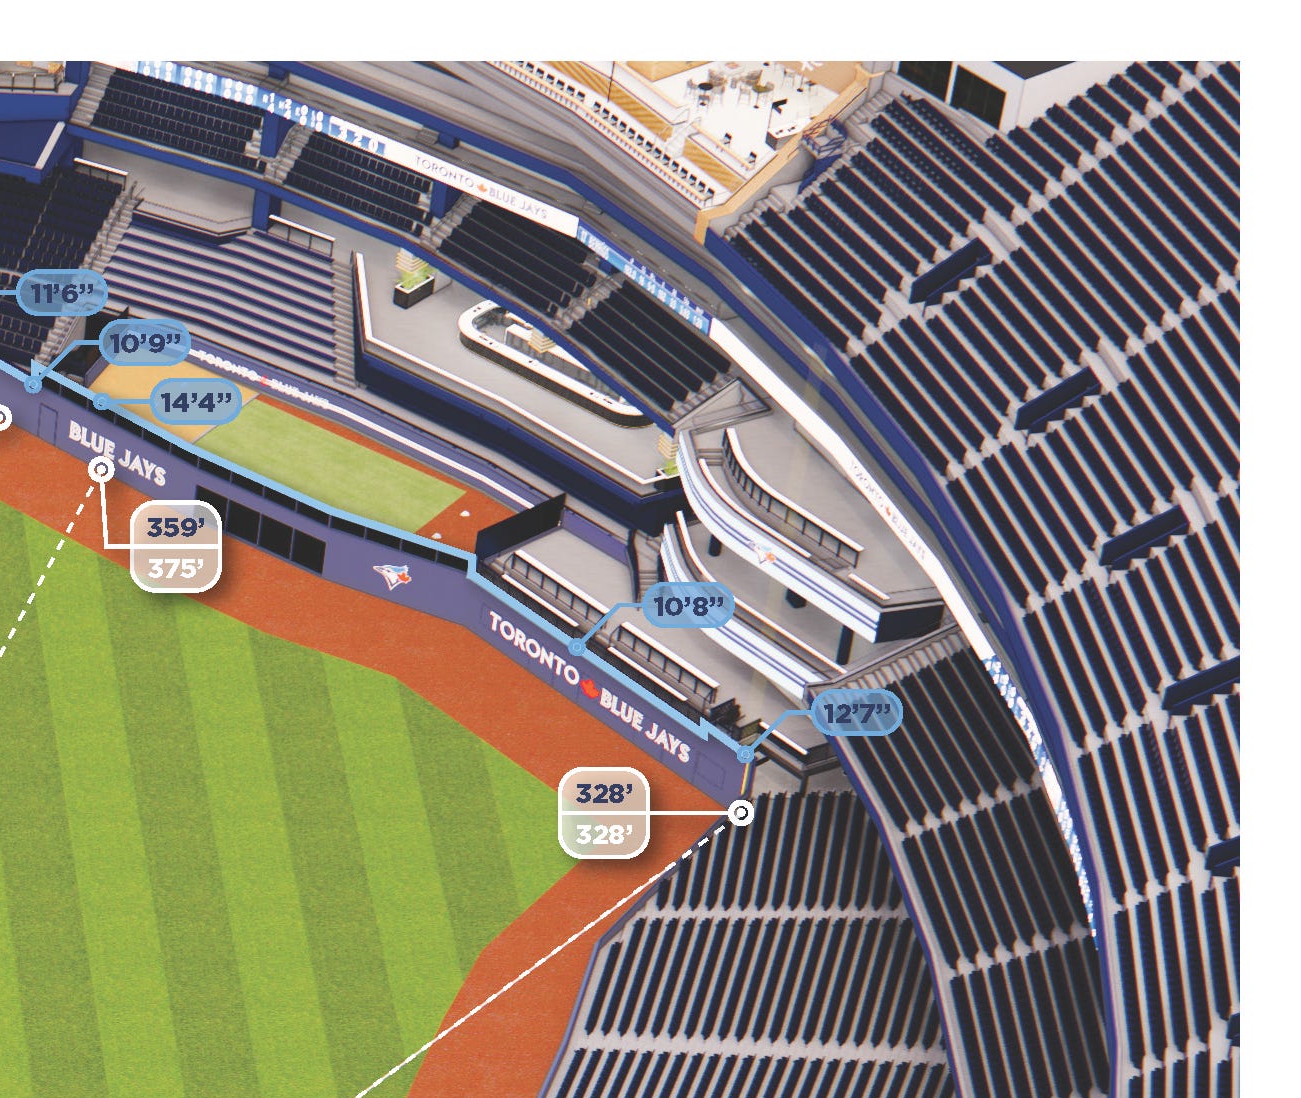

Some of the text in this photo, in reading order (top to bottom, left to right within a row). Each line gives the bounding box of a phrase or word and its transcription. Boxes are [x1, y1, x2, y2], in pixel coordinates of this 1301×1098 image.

[415, 156, 547, 220] TORONTO BLUE JAYS
[199, 349, 258, 381] TORONTO
[69, 420, 166, 486] BLUE JAYS
[490, 610, 691, 763] TORONTO BLUE JAYS
